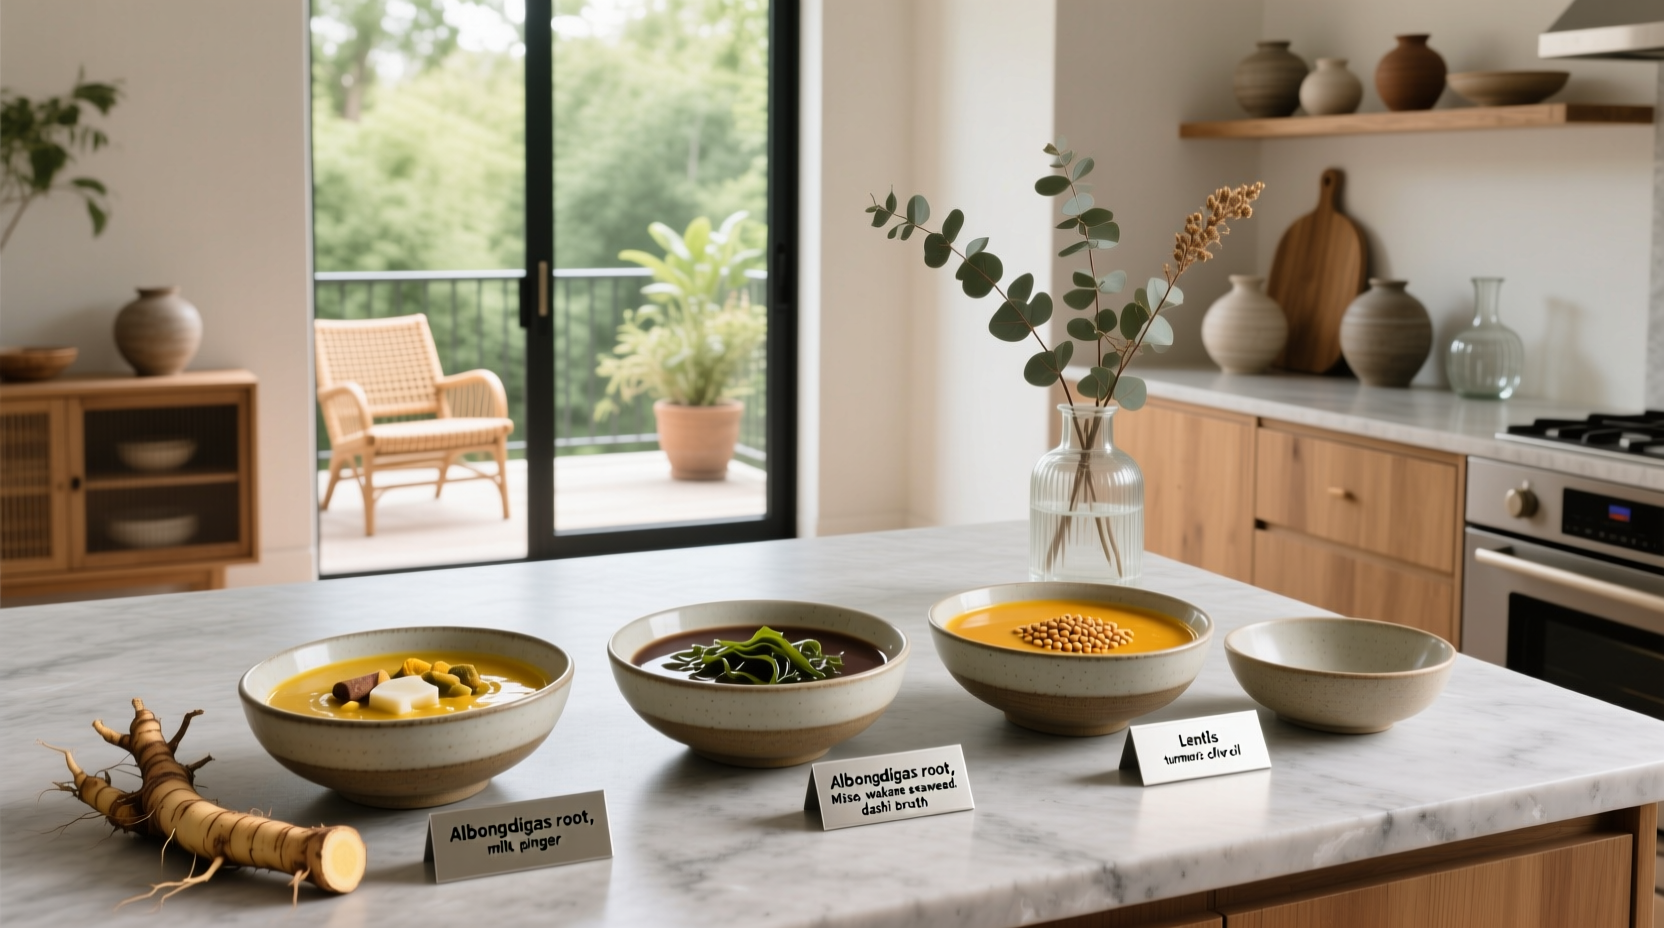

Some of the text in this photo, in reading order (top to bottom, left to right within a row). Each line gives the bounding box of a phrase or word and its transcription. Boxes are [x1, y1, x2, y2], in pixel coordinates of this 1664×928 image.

[830, 762, 955, 789] Albongdigas root,
[862, 800, 891, 816] dashi
[450, 810, 594, 842] Albongdigas root,
